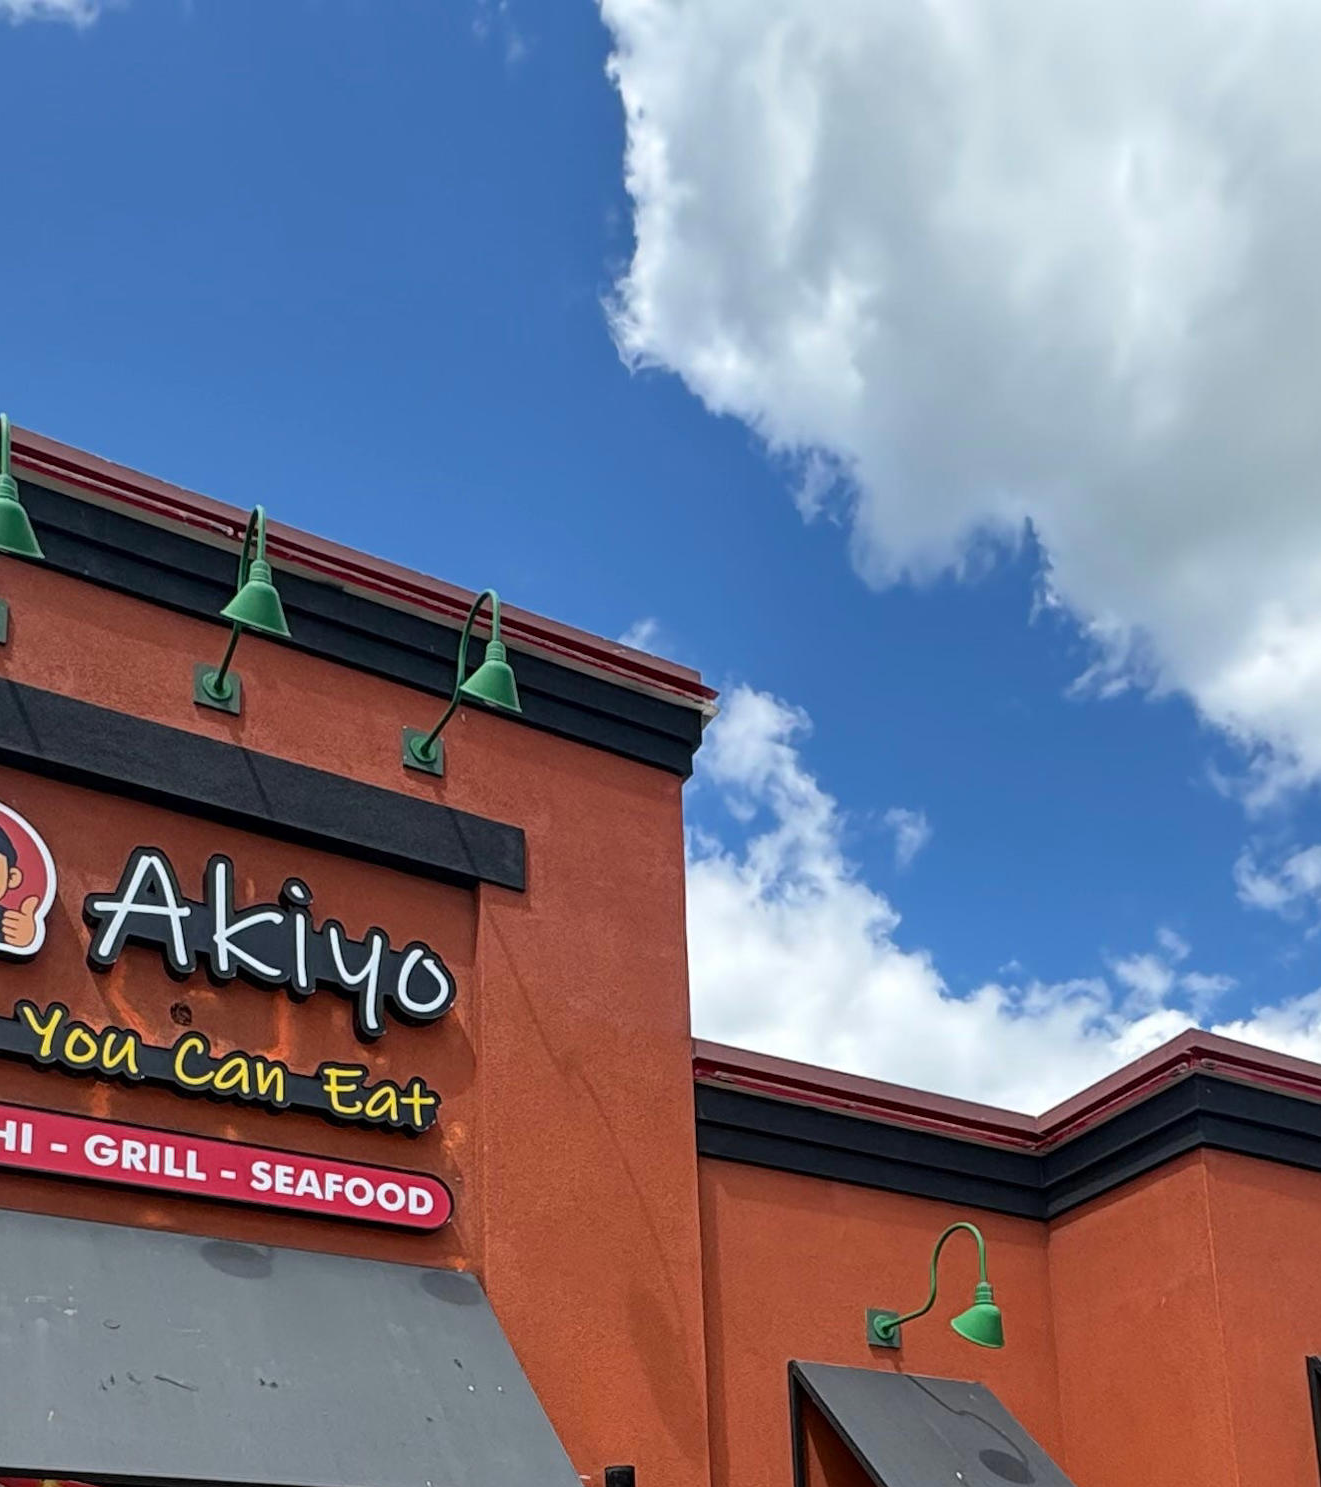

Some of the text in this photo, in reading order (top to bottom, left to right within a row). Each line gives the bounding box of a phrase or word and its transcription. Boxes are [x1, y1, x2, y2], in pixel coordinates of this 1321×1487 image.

[93, 854, 450, 1028] Akiyo
[24, 1004, 140, 1075] You
[174, 1036, 285, 1103] Can
[323, 1066, 436, 1126] Eat
[83, 1134, 207, 1181] GRILL
[249, 1160, 434, 1216] SEAFOOD
